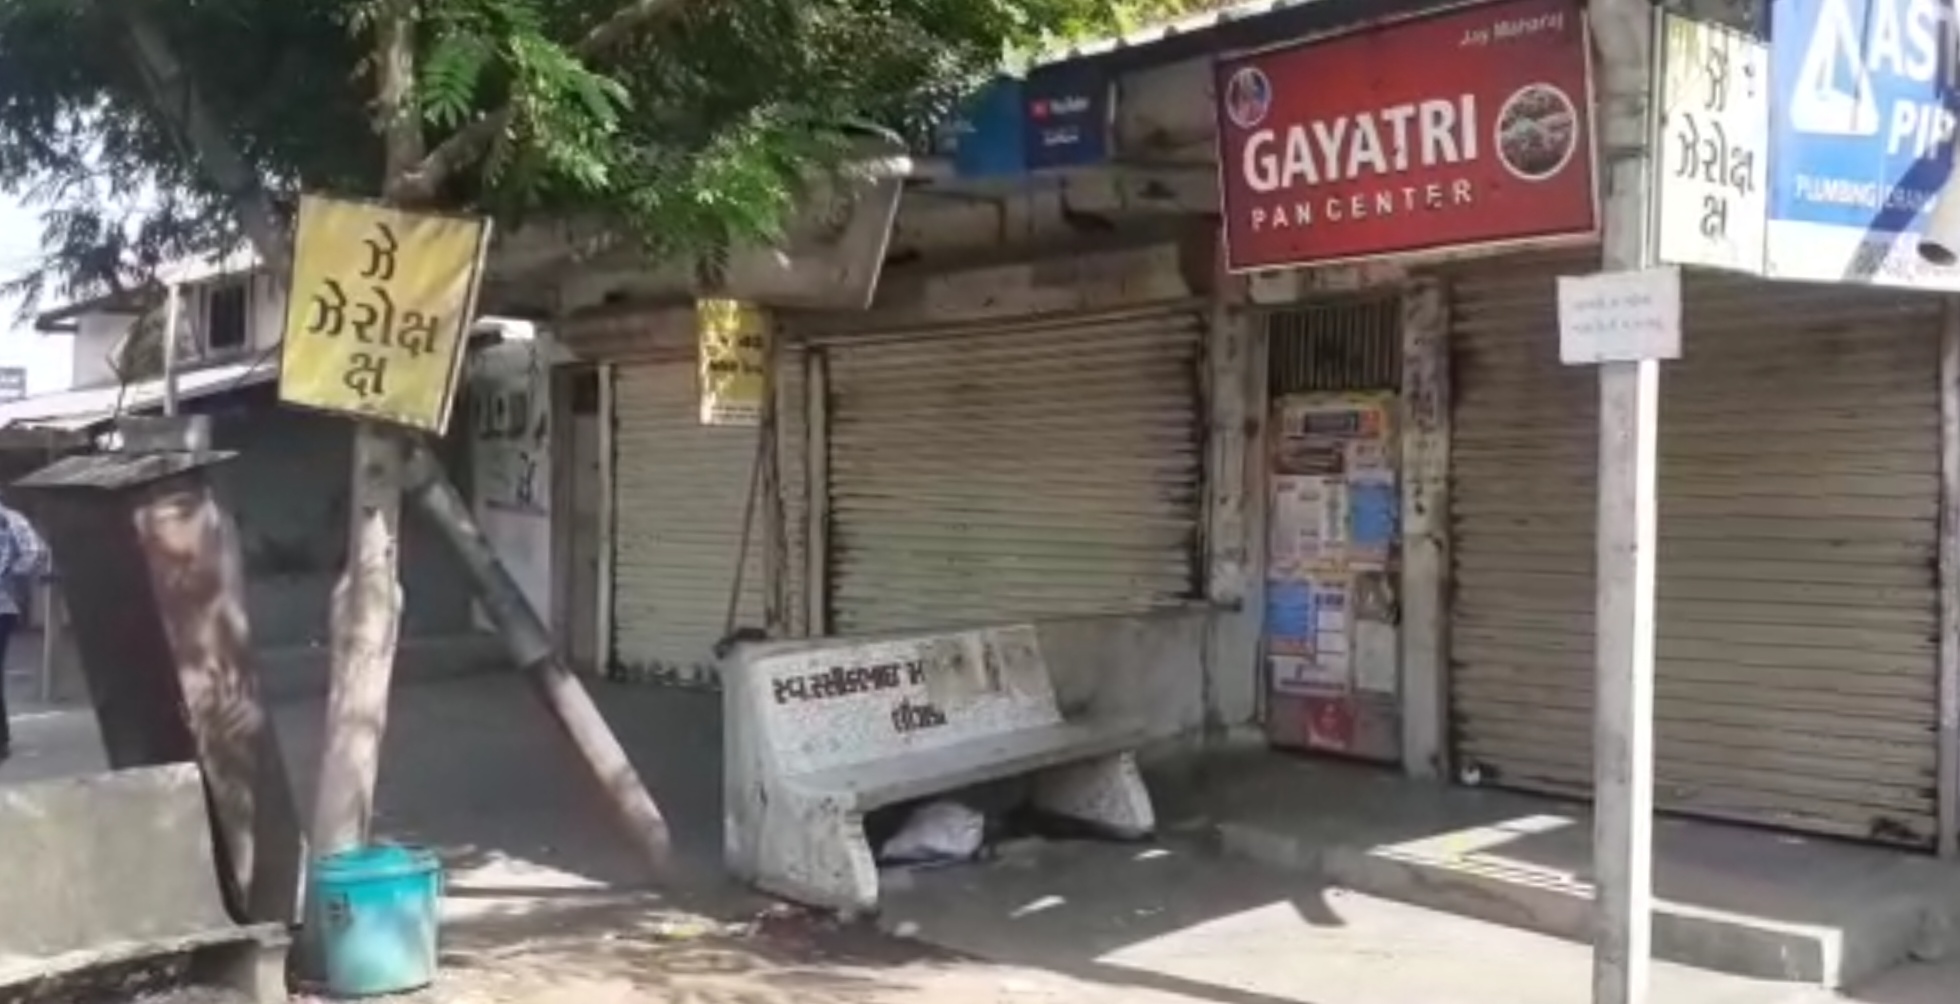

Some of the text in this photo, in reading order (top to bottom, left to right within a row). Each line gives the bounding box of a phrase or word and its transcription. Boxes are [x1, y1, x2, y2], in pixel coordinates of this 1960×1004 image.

[1242, 94, 1478, 192] GAYATRI
[1251, 177, 1474, 231] PAN CENTER
[360, 221, 399, 281] ઝે
[305, 277, 440, 360] ઝેરોક્ષ
[342, 351, 389, 399] ક્ષ
